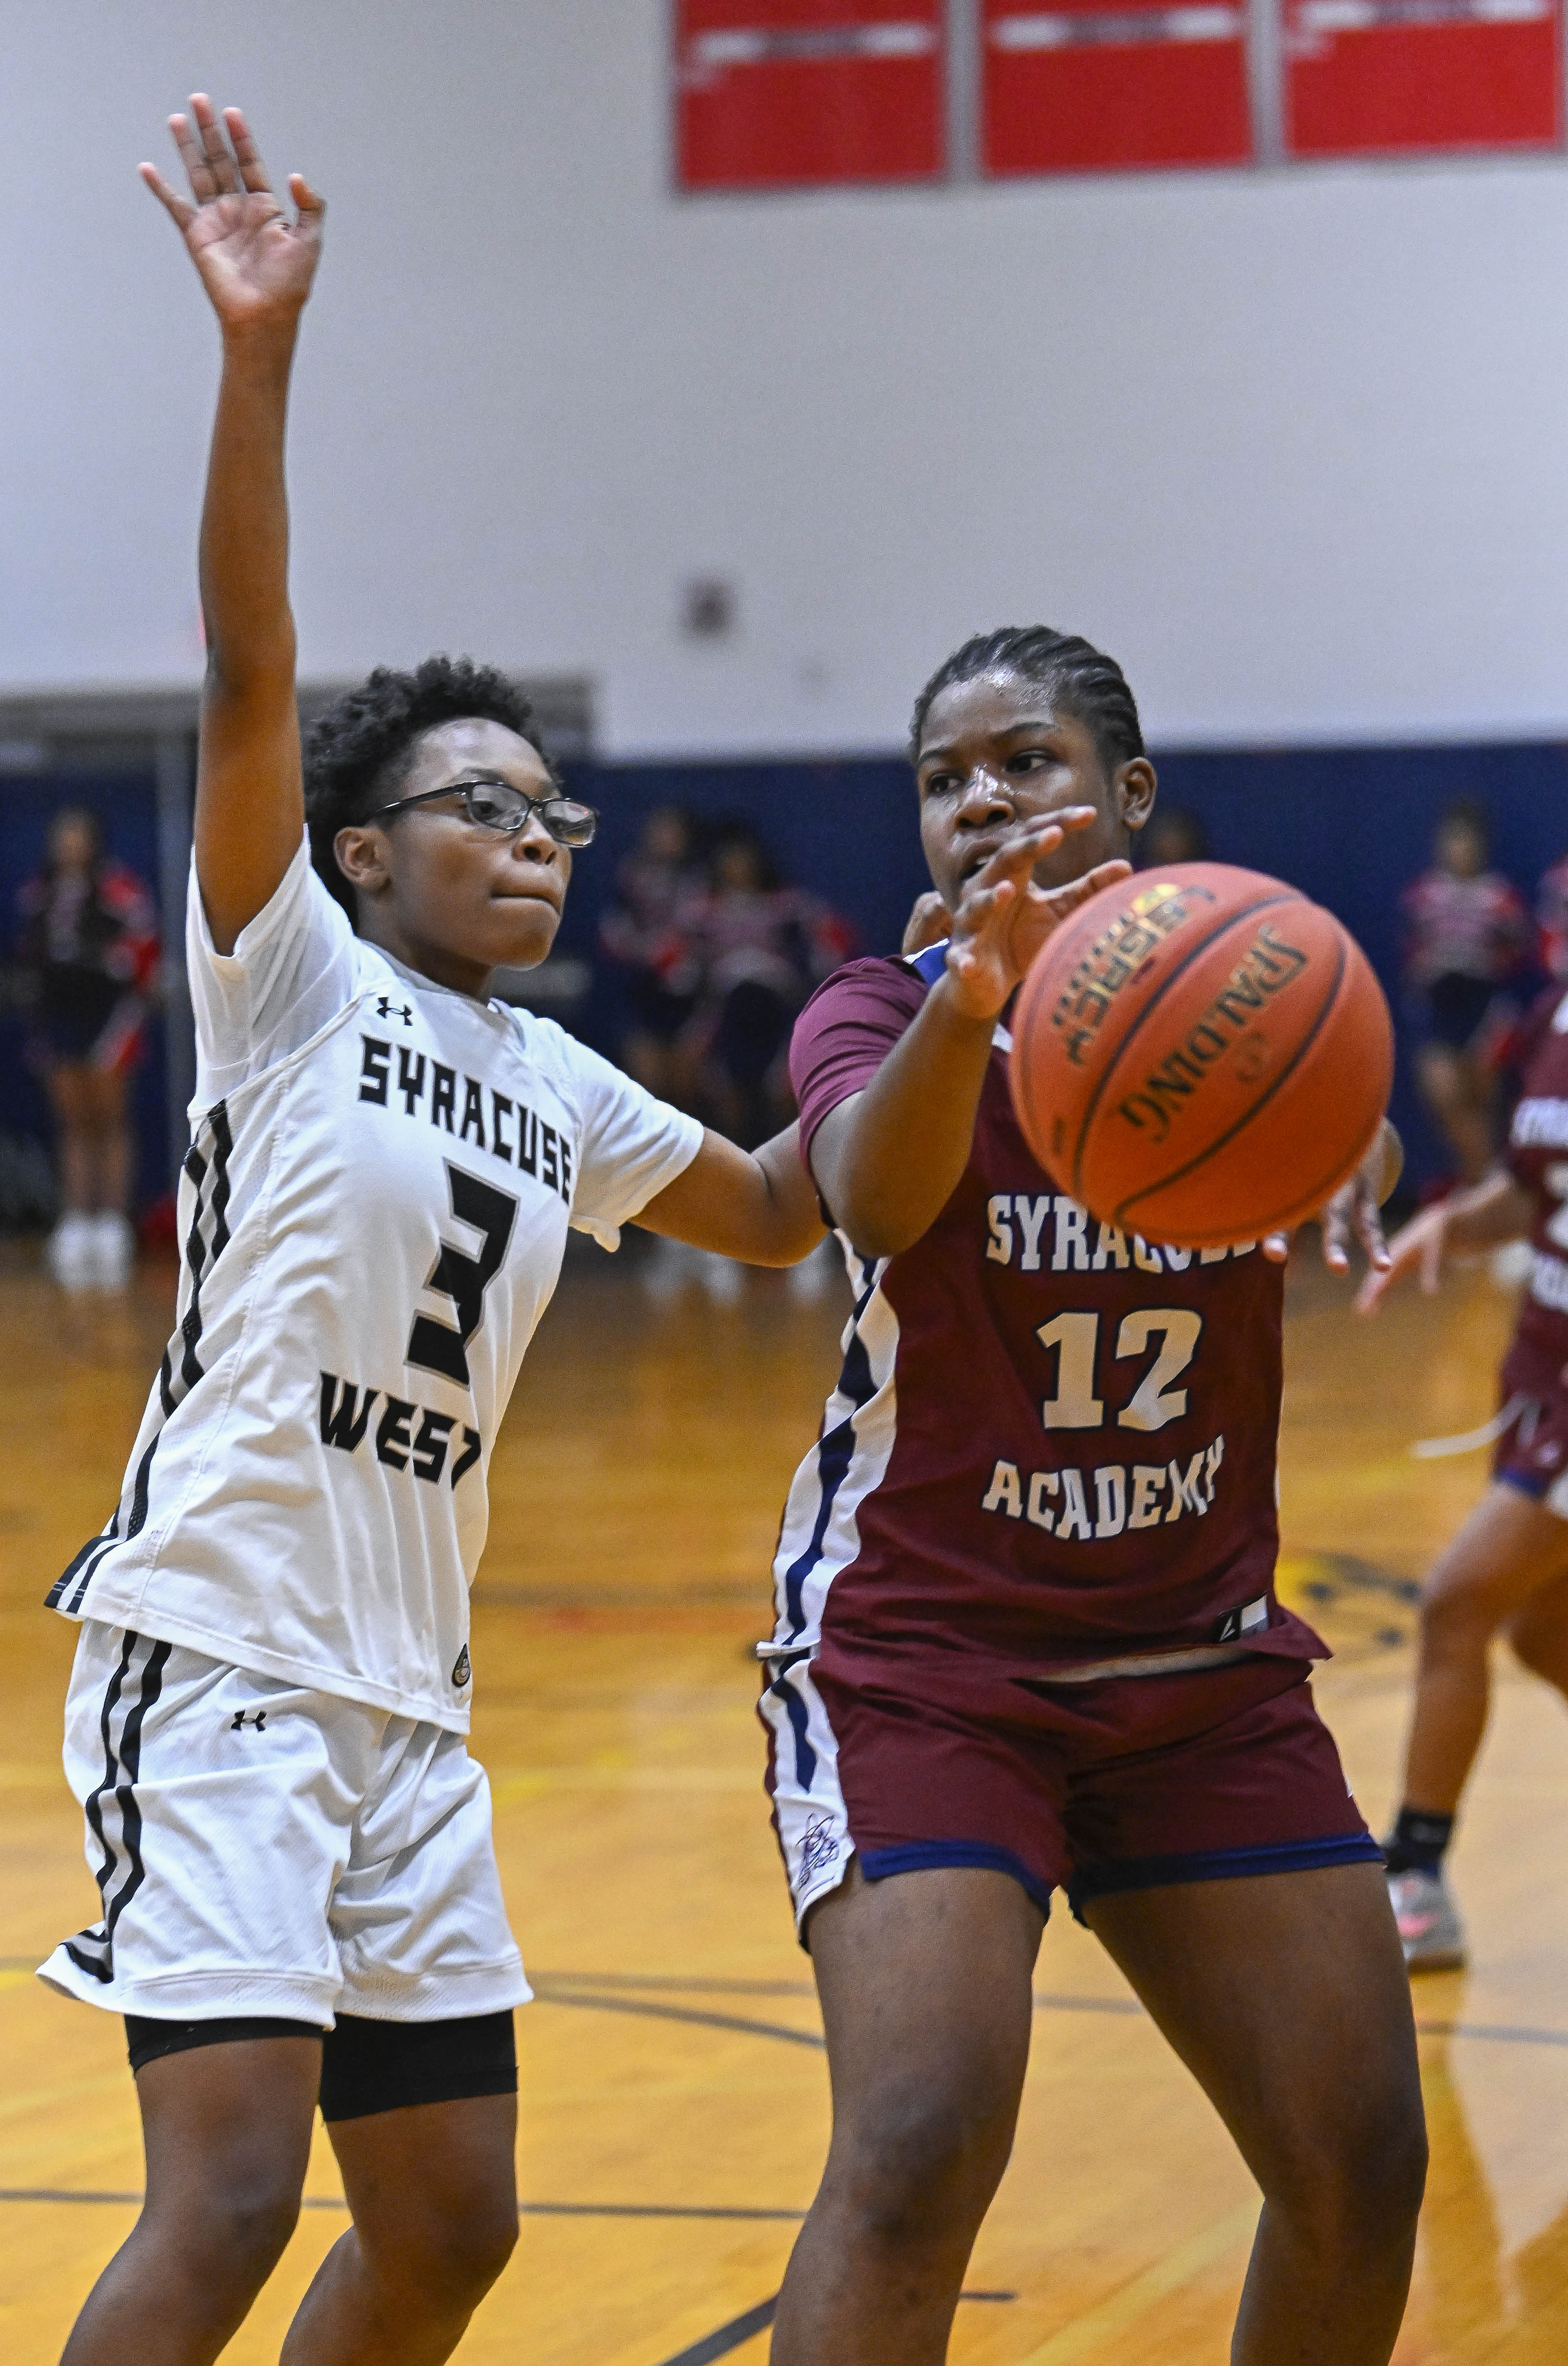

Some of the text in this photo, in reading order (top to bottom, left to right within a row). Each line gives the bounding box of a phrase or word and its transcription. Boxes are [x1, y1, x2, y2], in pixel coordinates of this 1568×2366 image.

[1118, 923, 1307, 1143] SPALDING
[358, 1033, 572, 1207] SYRACUSE
[403, 1156, 521, 1391] 3
[986, 1195, 1256, 1274] SYRA
[1036, 1308, 1203, 1432] 12
[981, 1434, 1225, 1541] ACADEMY
